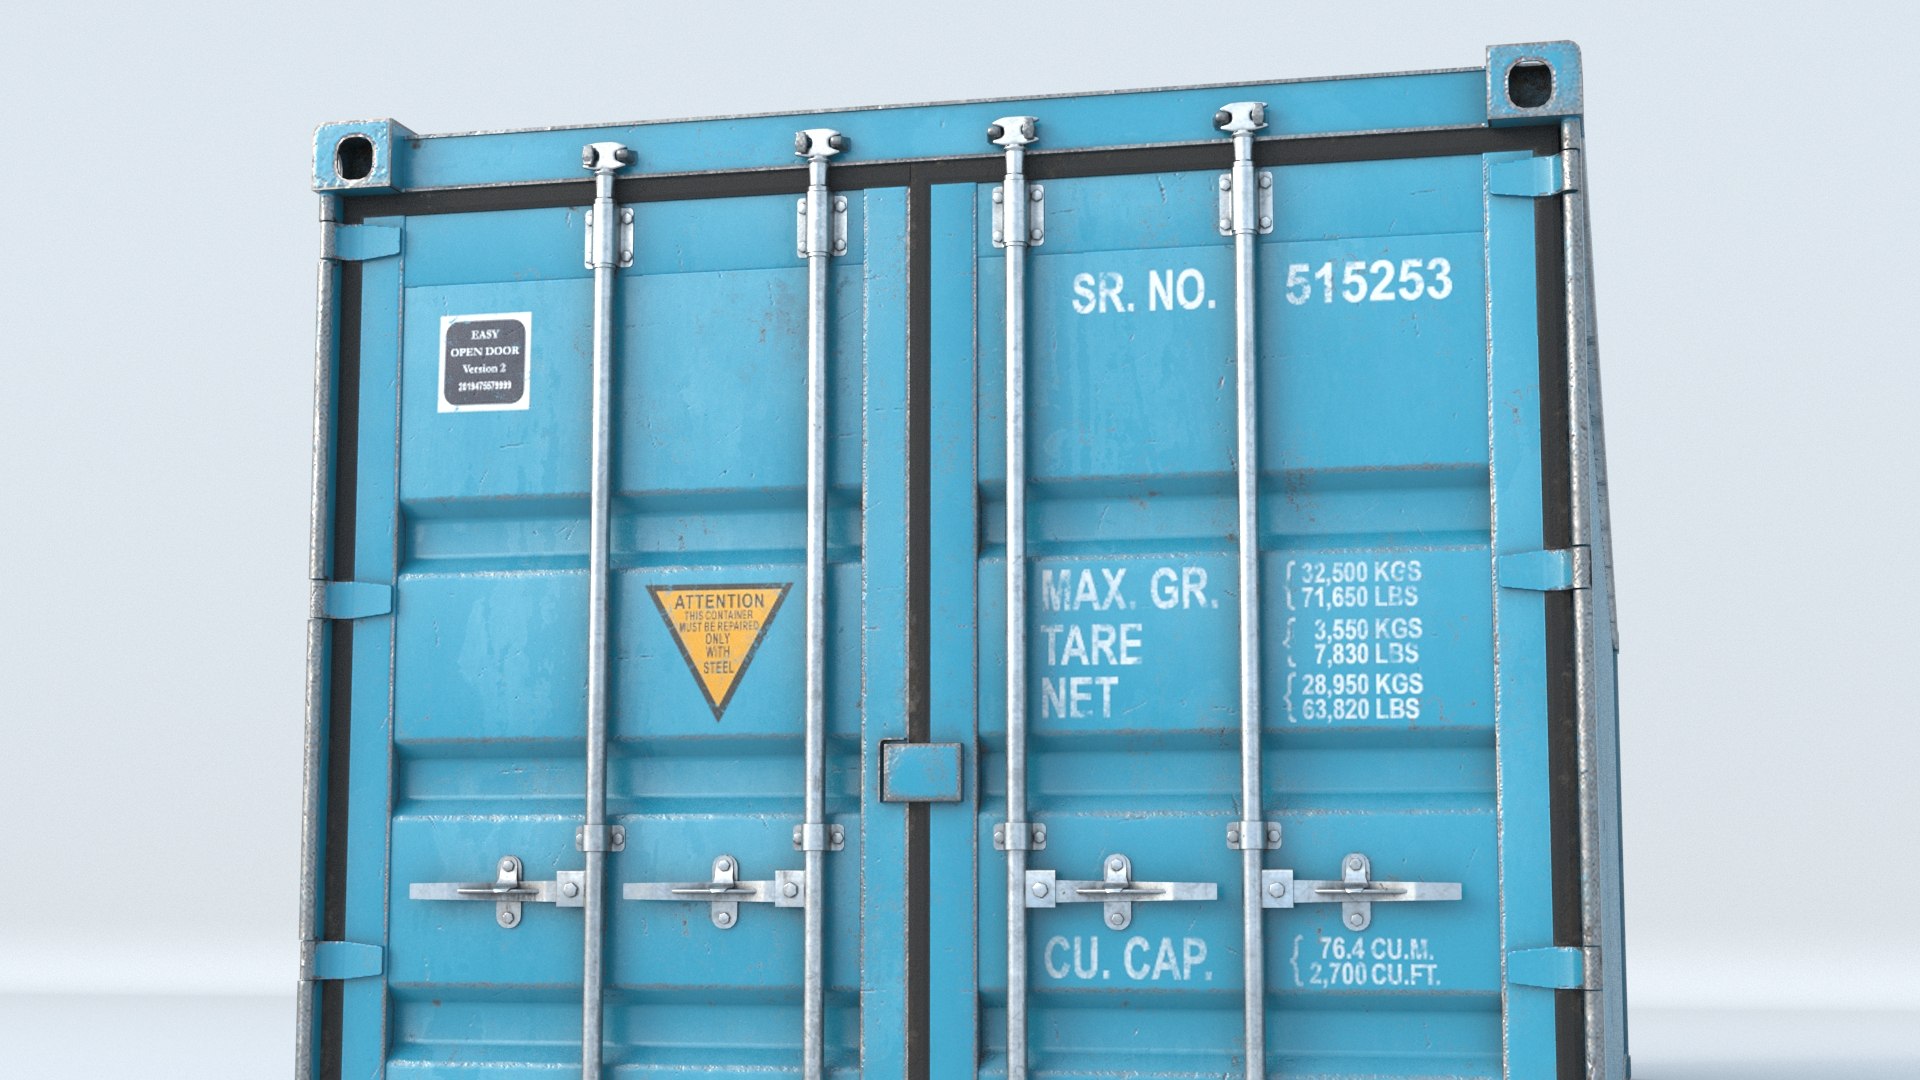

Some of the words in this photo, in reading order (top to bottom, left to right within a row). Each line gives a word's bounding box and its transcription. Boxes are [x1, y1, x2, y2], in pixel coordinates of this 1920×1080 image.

[1072, 270, 1135, 315] SR.
[1149, 267, 1216, 312] NO.
[1285, 256, 1453, 306] 515253
[470, 329, 500, 340] EASY
[450, 347, 483, 357] OPEN
[485, 346, 520, 356] DOOR
[462, 364, 498, 374] Version
[499, 363, 507, 373] 2
[1301, 561, 1368, 587] 32,500
[1374, 560, 1422, 583] KGS
[674, 593, 765, 610] ATTENTION
[1041, 567, 1136, 612] MAX.
[1150, 566, 1219, 610] GR.
[1301, 586, 1368, 611] 71,650
[1374, 585, 1418, 607] LBS
[679, 622, 702, 633] MUST
[704, 621, 716, 632] BE
[717, 620, 759, 631] REPAIRED
[684, 610, 703, 621] THIS
[705, 609, 753, 620] CONTAINER
[705, 632, 731, 645] ONLY
[1314, 618, 1369, 644] 3,550
[1374, 617, 1423, 640] KGS
[705, 645, 731, 658] WITH
[1040, 623, 1143, 666] TARE
[1314, 643, 1369, 668] 7,830
[1375, 642, 1419, 664] LBS
[703, 660, 734, 674] STEEL
[1041, 676, 1119, 719] NET
[1302, 673, 1369, 698] 28,950
[1375, 672, 1424, 695] KGS
[1302, 698, 1370, 723] 63,820
[1376, 697, 1420, 720] LBS
[1044, 935, 1110, 980] CU.
[1123, 936, 1213, 981] CAP.
[1320, 936, 1365, 960] 76.4
[1371, 937, 1434, 960] CU.M.
[1309, 961, 1367, 989] 2,700
[1371, 963, 1440, 986] CU.FT.
